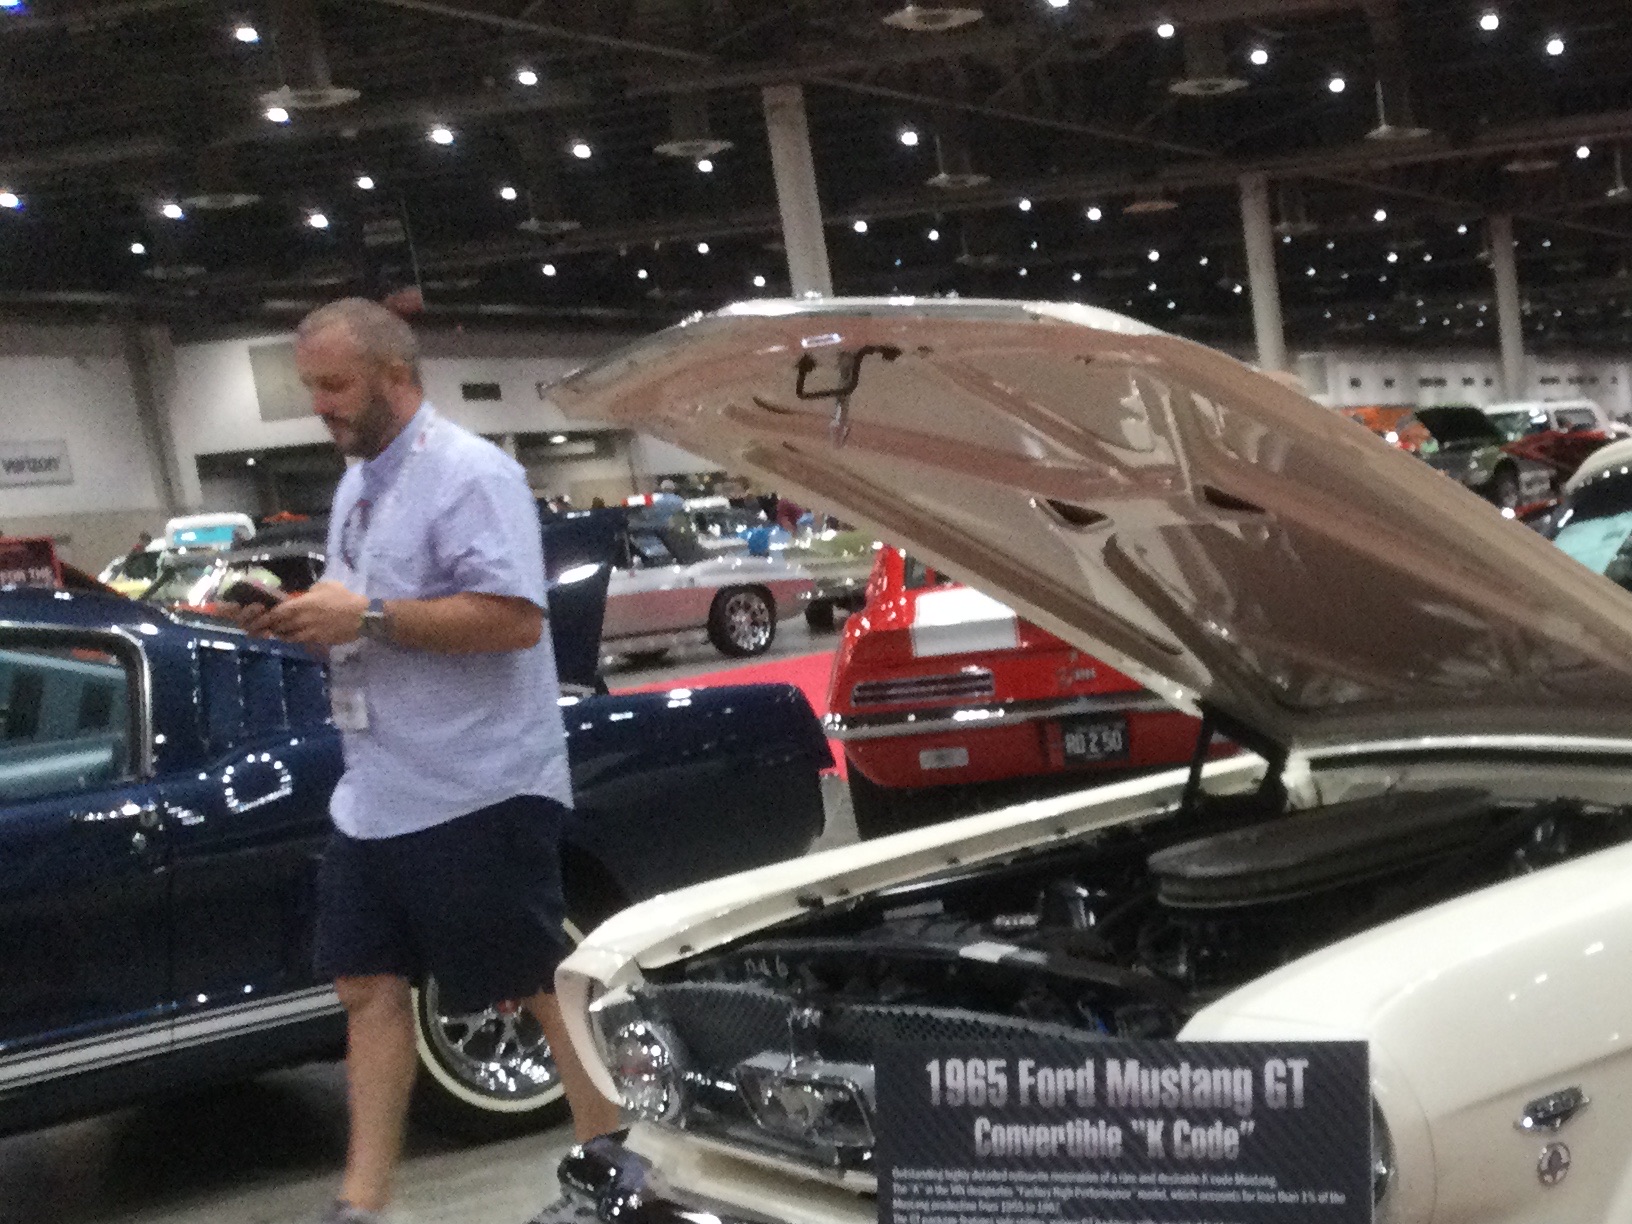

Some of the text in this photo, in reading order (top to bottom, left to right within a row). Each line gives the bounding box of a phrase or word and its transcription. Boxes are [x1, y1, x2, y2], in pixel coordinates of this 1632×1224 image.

[926, 1058, 1310, 1115] 1965 Ford Mustang GT
[975, 1117, 1123, 1158] Convertible
